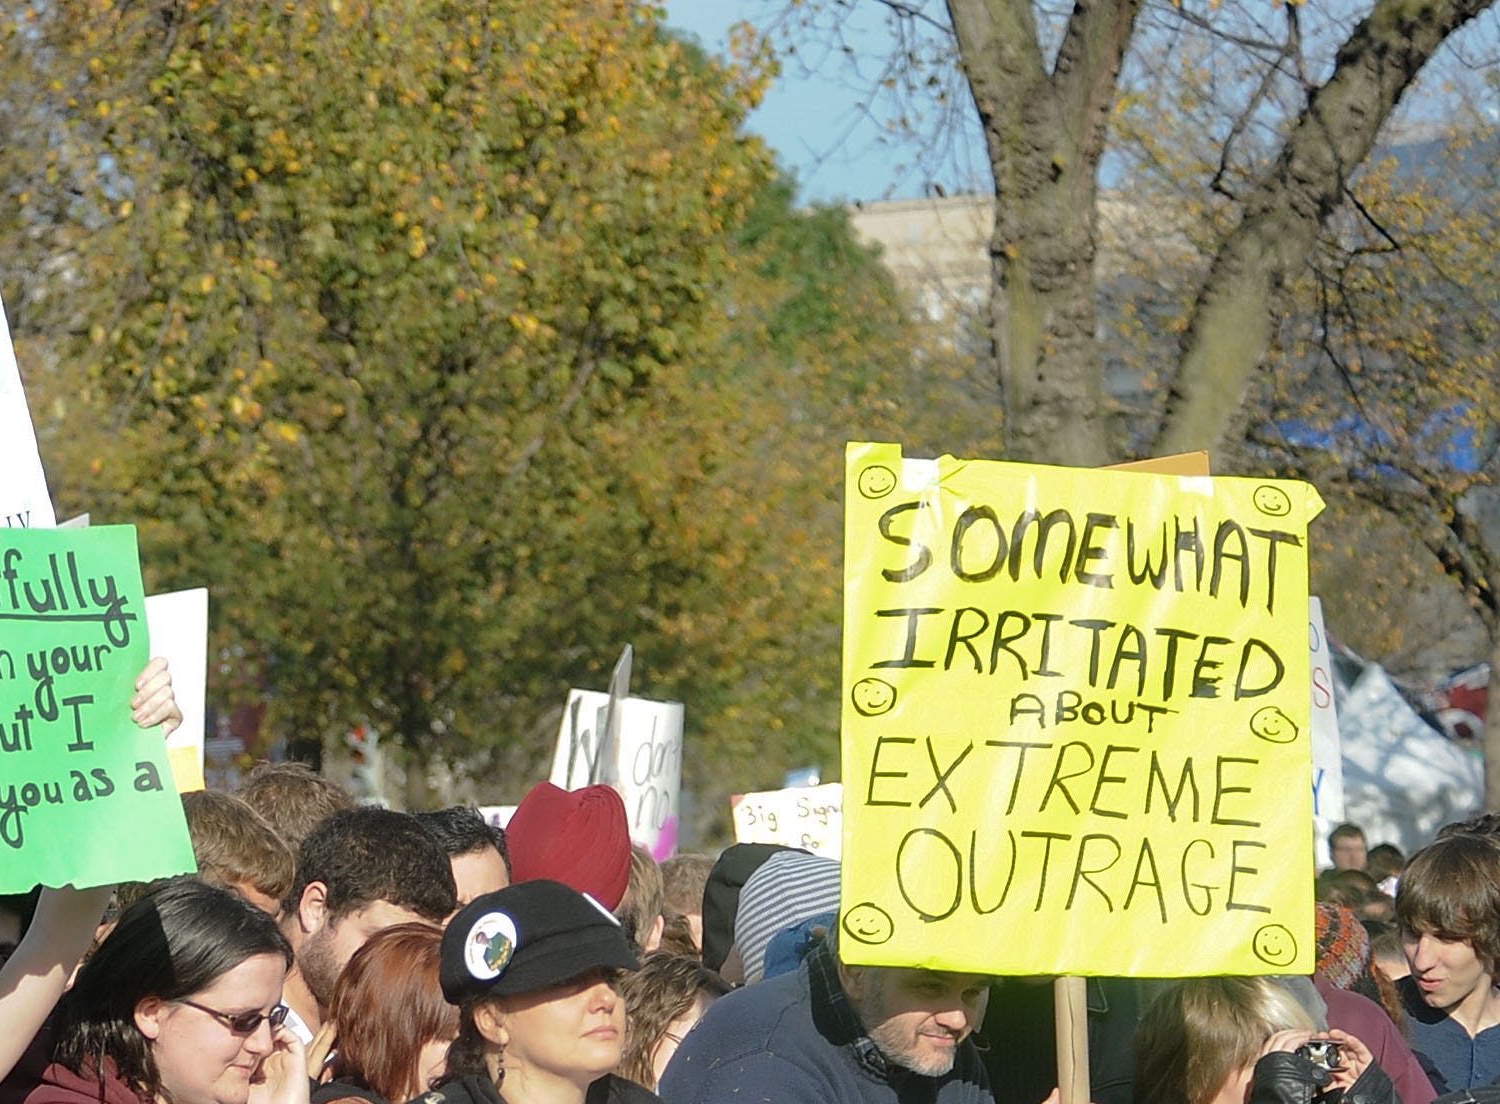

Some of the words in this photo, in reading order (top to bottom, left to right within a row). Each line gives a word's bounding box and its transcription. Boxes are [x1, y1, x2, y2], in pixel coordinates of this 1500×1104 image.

[878, 501, 1303, 616] SOMEWHAT
[27, 643, 111, 721] your
[869, 606, 1285, 700] IRRITATED
[61, 695, 95, 752] I
[1009, 691, 1179, 733] ABOUT
[72, 768, 116, 802] as
[133, 760, 164, 792] a
[864, 736, 1261, 828] EXTREME
[896, 828, 1271, 924] OUTRAGE
